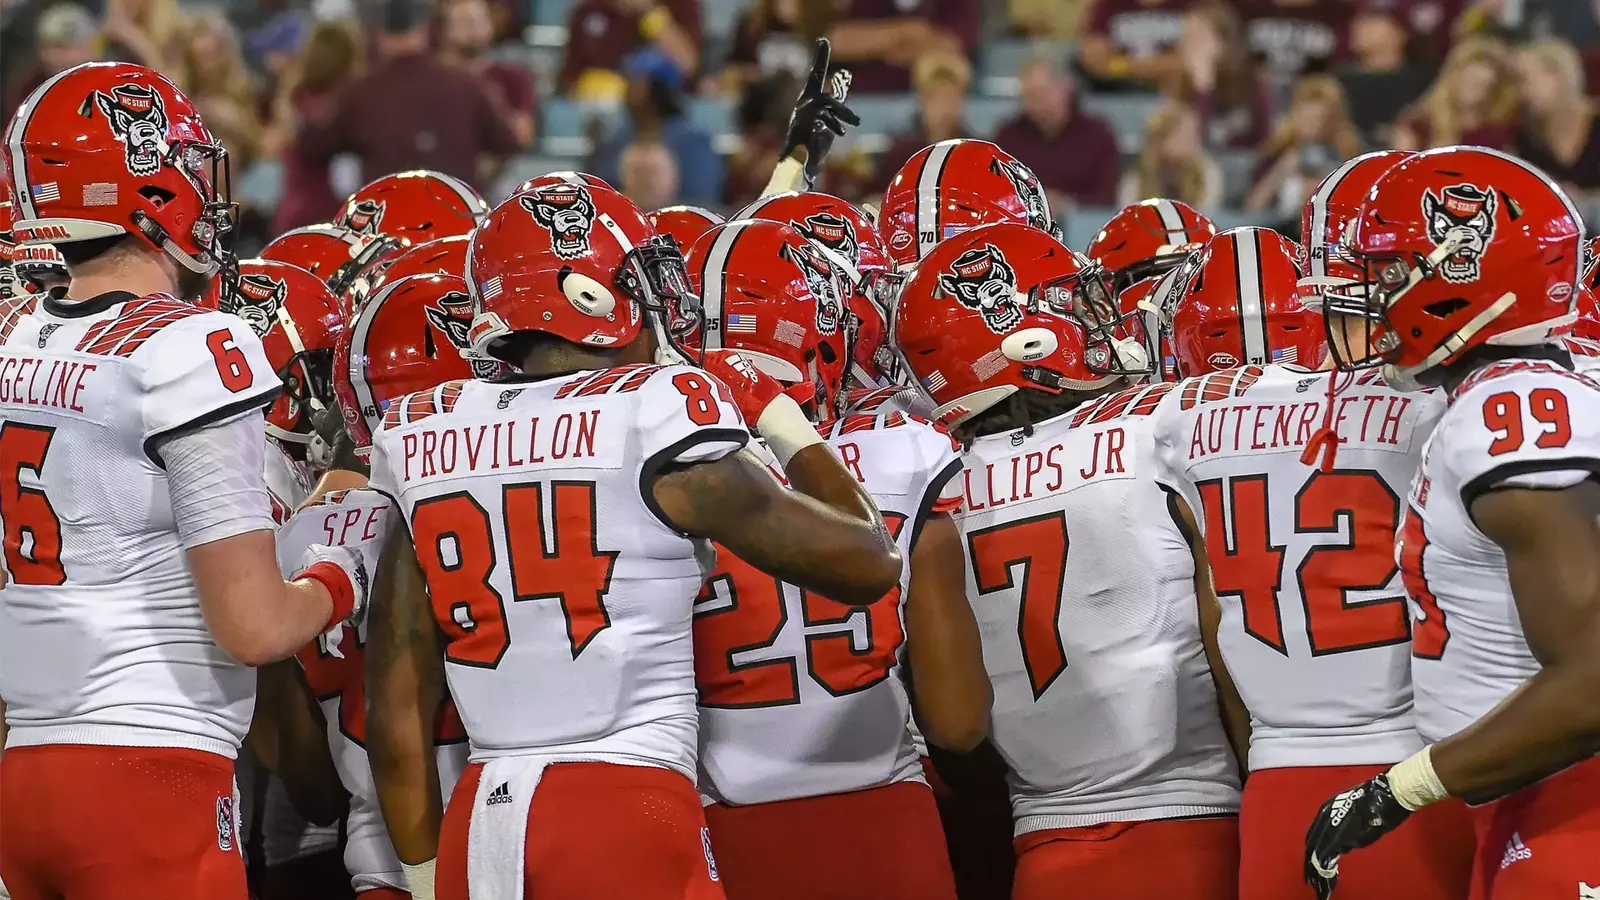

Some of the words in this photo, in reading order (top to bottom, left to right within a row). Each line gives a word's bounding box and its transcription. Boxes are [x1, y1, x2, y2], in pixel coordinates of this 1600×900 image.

[122, 97, 131, 105] NC
[132, 99, 149, 107] STATE
[21, 191, 26, 203] 6
[816, 226, 825, 235] NC
[826, 228, 842, 236] STATE
[921, 231, 934, 243] 70
[961, 267, 971, 275] NC
[972, 260, 990, 273] STATE
[1311, 246, 1323, 259] 42
[251, 287, 270, 298] STATE
[206, 328, 254, 394] 6
[1211, 356, 1234, 364] ACC
[0, 357, 97, 414] GELINE
[363, 405, 376, 418] 46
[1483, 387, 1572, 457] 99
[403, 410, 600, 482] PROVILLON
[952, 444, 1064, 515] LLIPS
[1080, 427, 1125, 480] JR
[0, 420, 67, 586] 6
[411, 480, 621, 670] 84
[1194, 469, 1412, 658] 42
[967, 509, 1070, 703] 7
